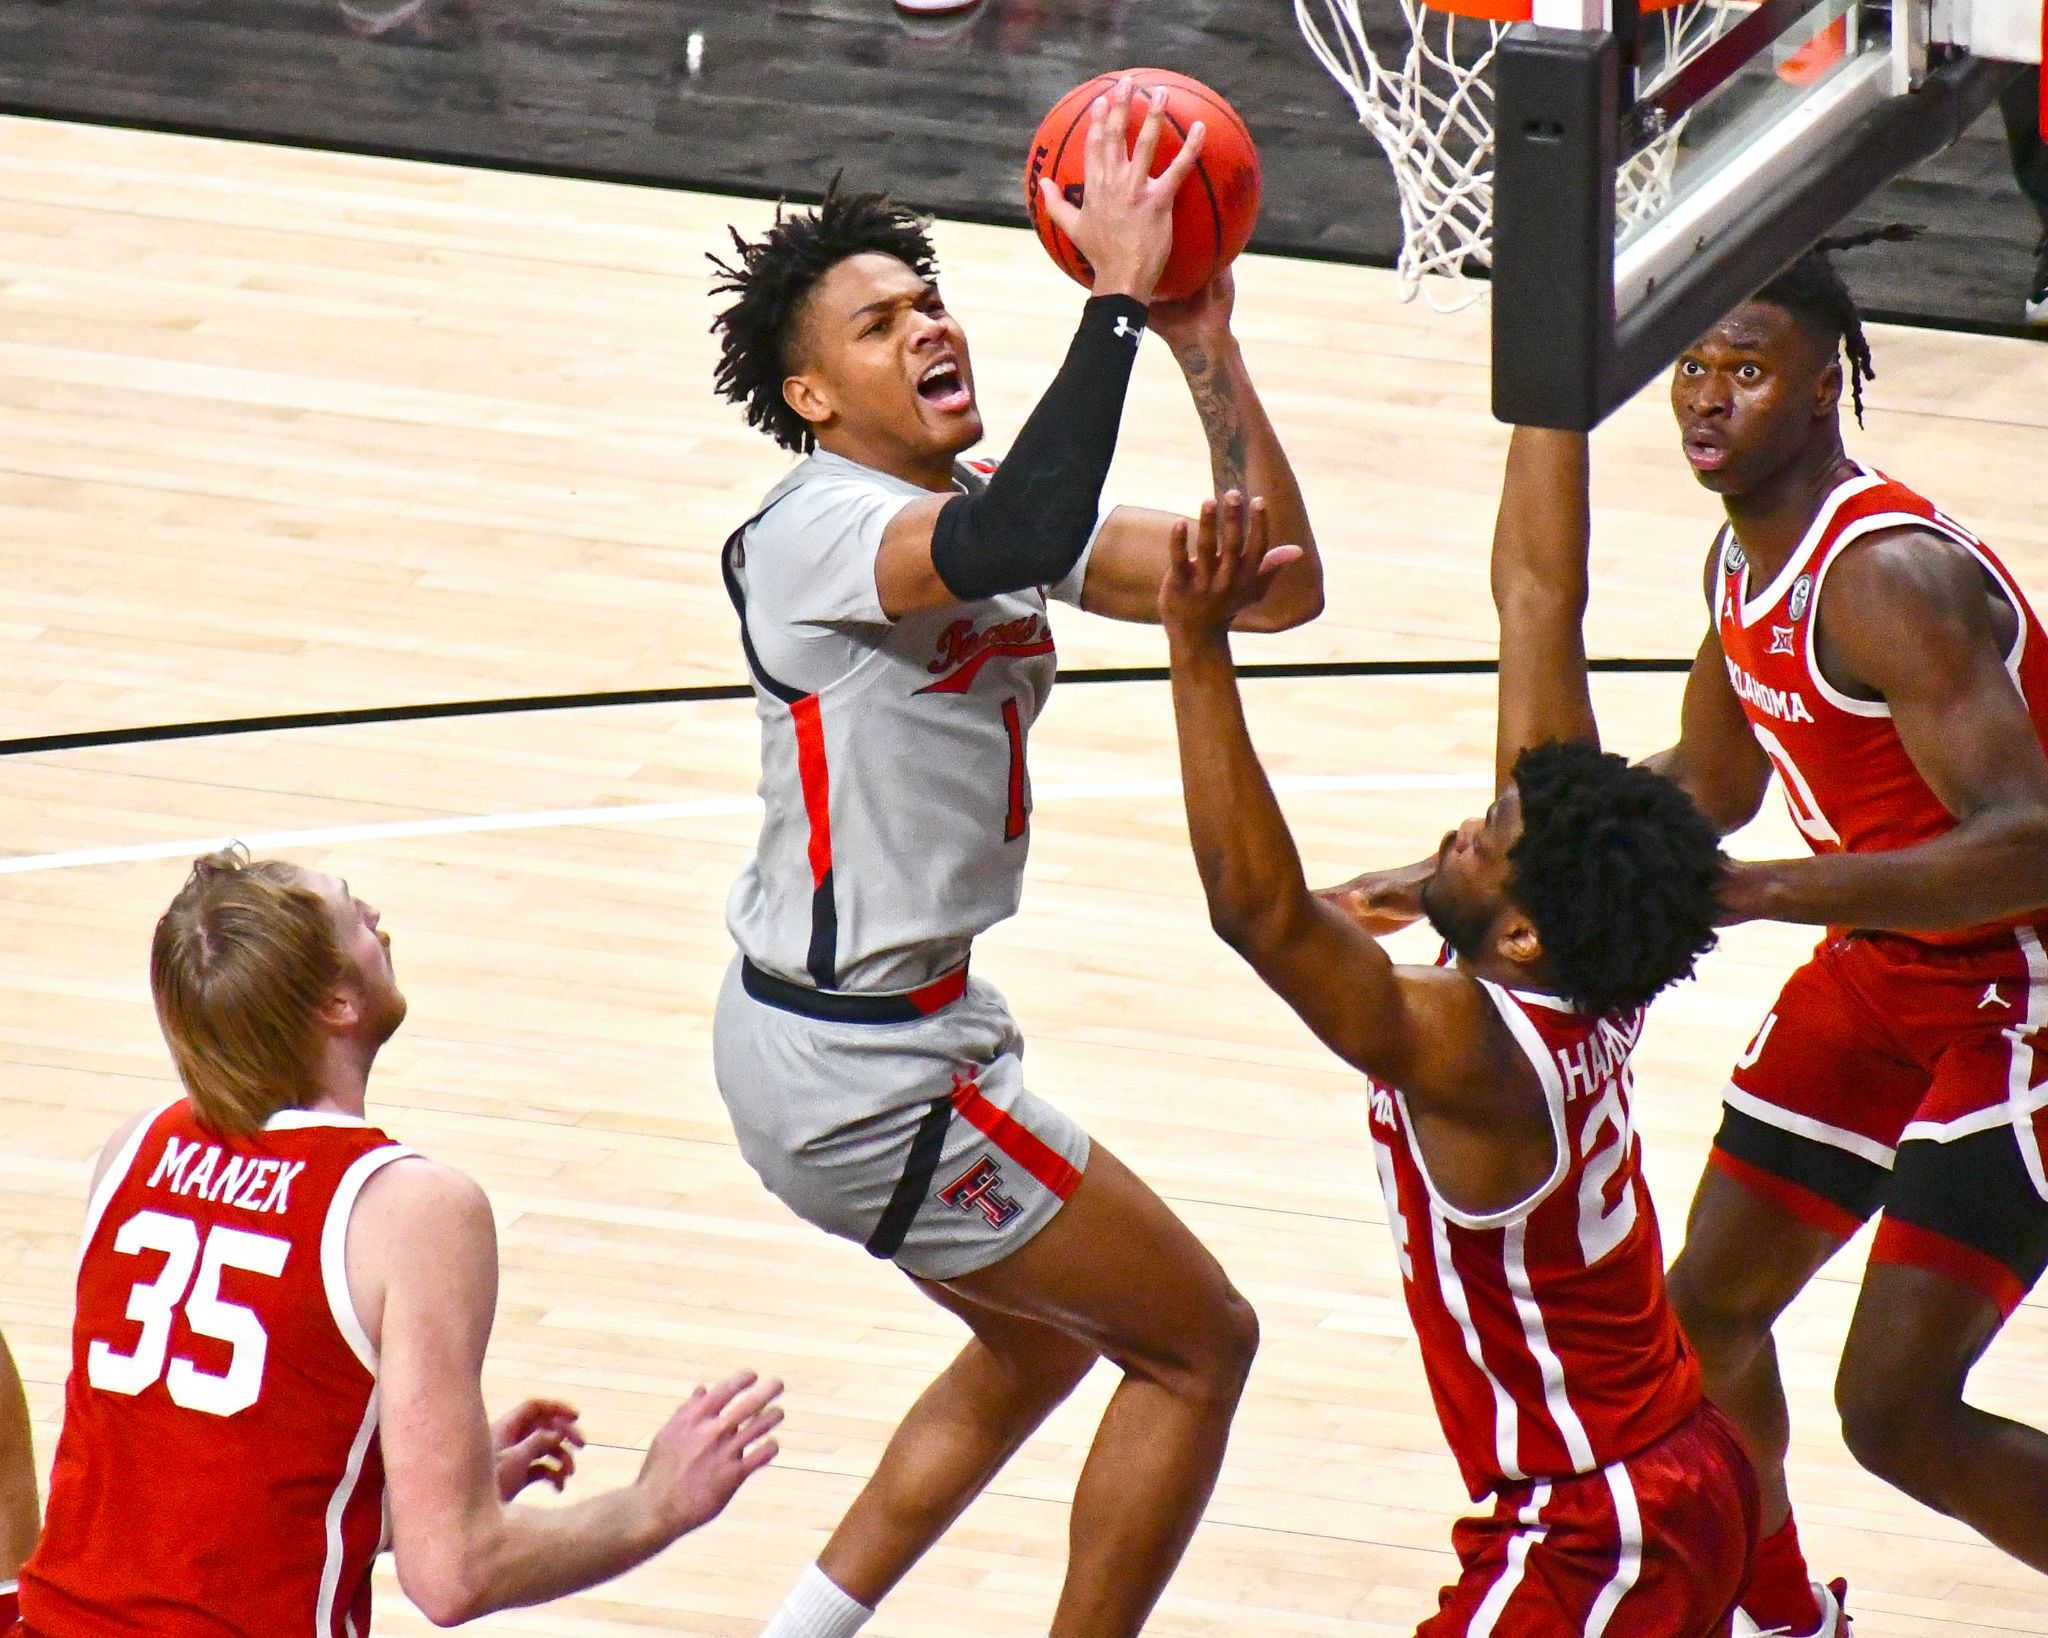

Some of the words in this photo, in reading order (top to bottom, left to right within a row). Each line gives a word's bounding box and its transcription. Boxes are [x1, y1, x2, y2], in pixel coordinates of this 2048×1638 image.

[1001, 695, 1026, 843] 1
[146, 1137, 306, 1215] MANEK
[87, 1209, 293, 1418] 35
